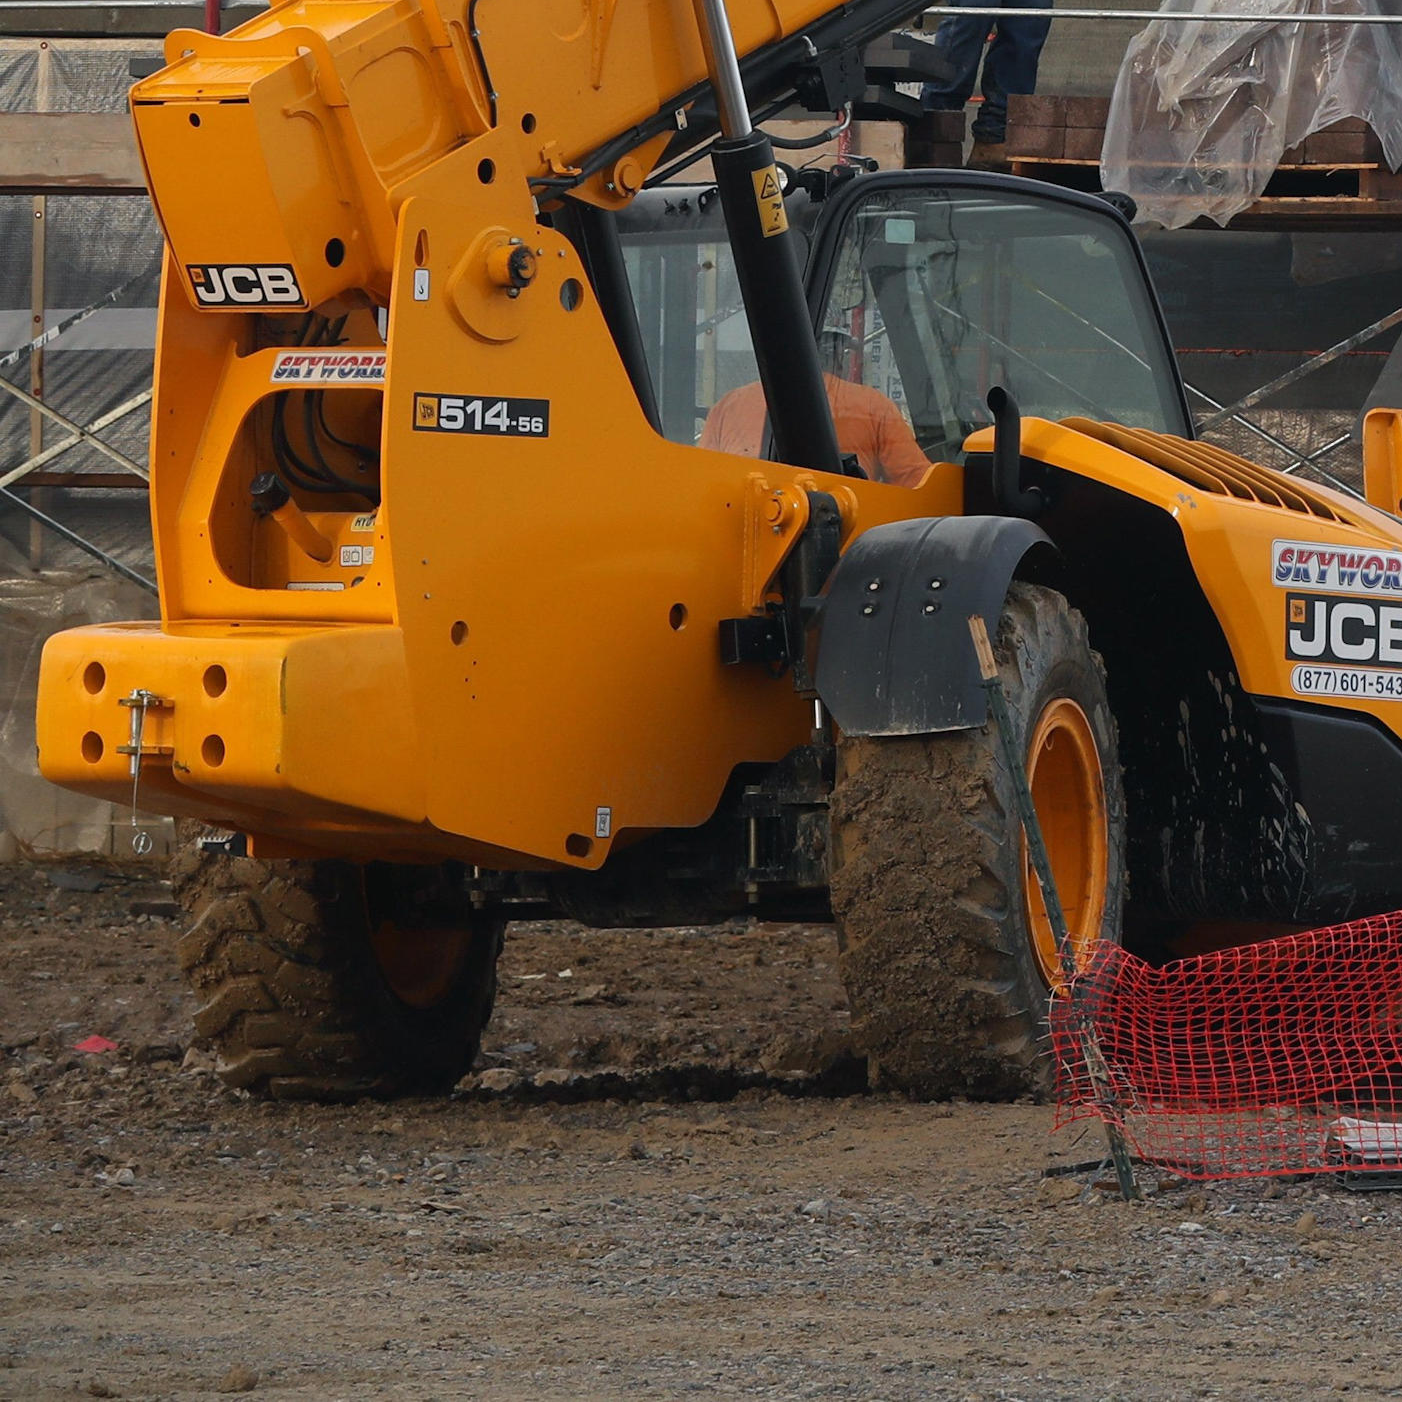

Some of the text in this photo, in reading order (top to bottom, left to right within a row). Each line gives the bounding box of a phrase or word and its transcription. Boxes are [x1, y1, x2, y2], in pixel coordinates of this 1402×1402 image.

[195, 266, 302, 304] JCB
[273, 356, 387, 380] SKYWORK
[438, 397, 545, 435] 514-56
